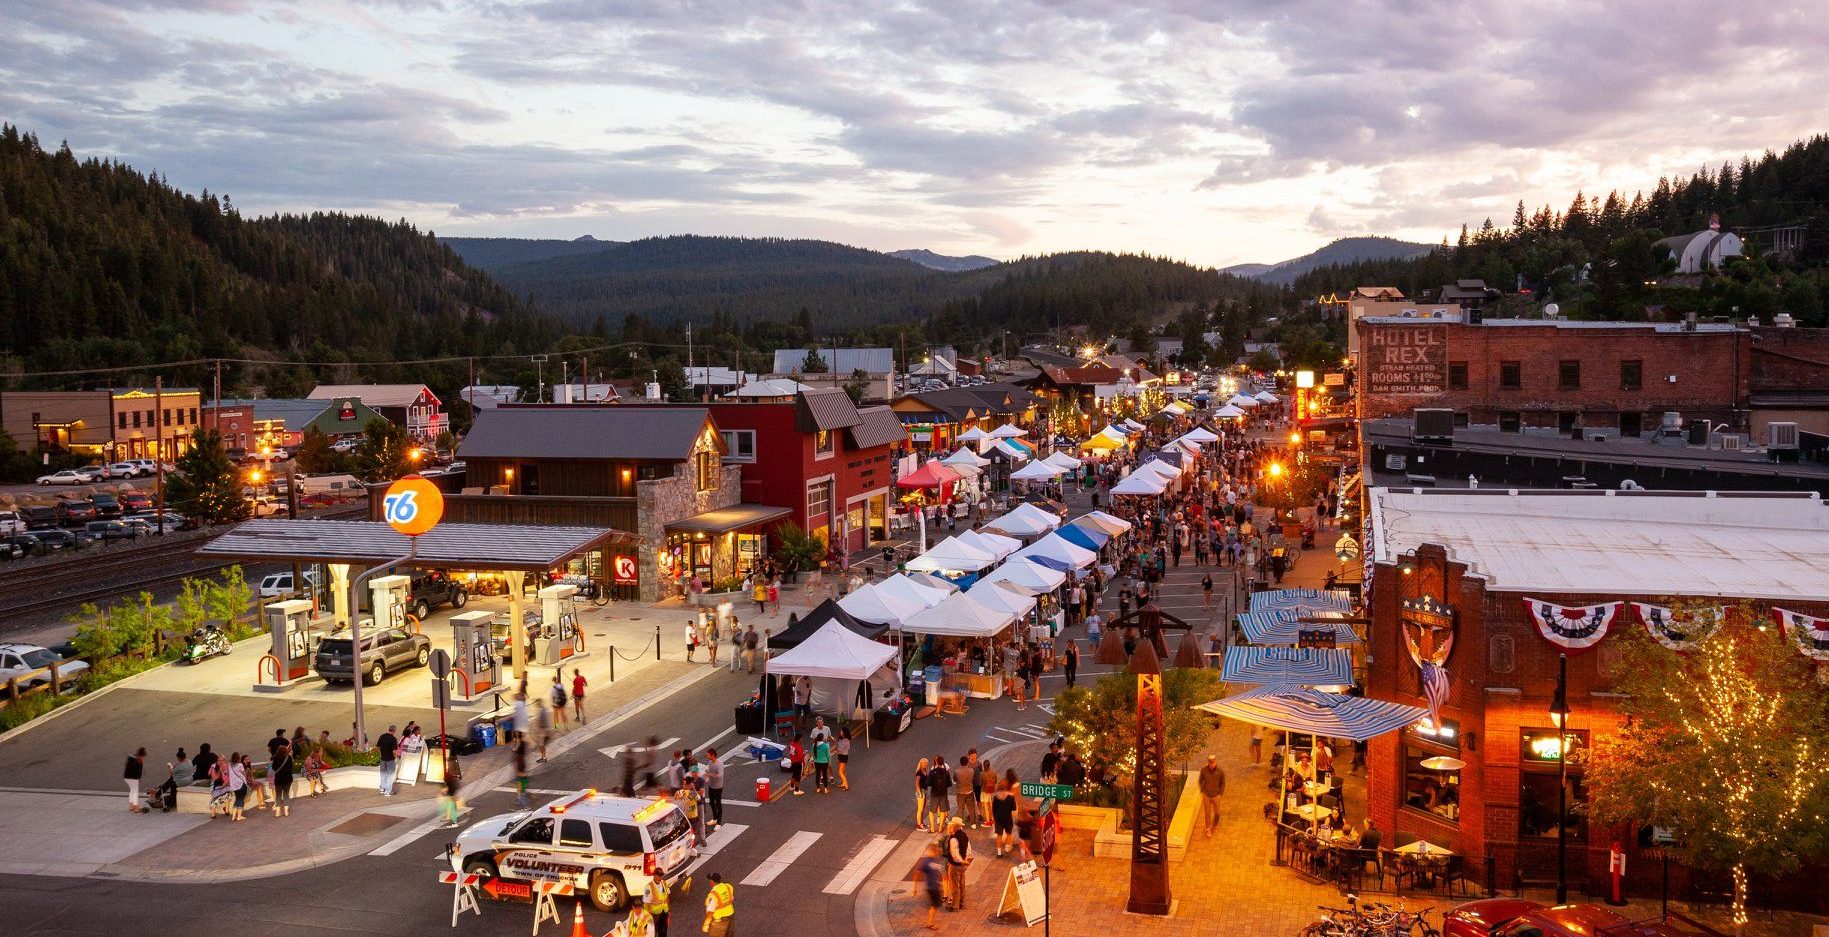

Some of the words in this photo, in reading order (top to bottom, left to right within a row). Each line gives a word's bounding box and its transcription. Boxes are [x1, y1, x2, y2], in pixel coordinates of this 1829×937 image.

[1372, 329, 1440, 345] HOTEL
[1386, 346, 1428, 363] REX
[1372, 372, 1410, 383] ROOMS
[384, 490, 418, 523] 76
[1022, 785, 1057, 797] BRIDGE
[1063, 790, 1072, 798] ST
[506, 858, 584, 874] VOLUNTEER
[496, 884, 528, 896] DETOUR
